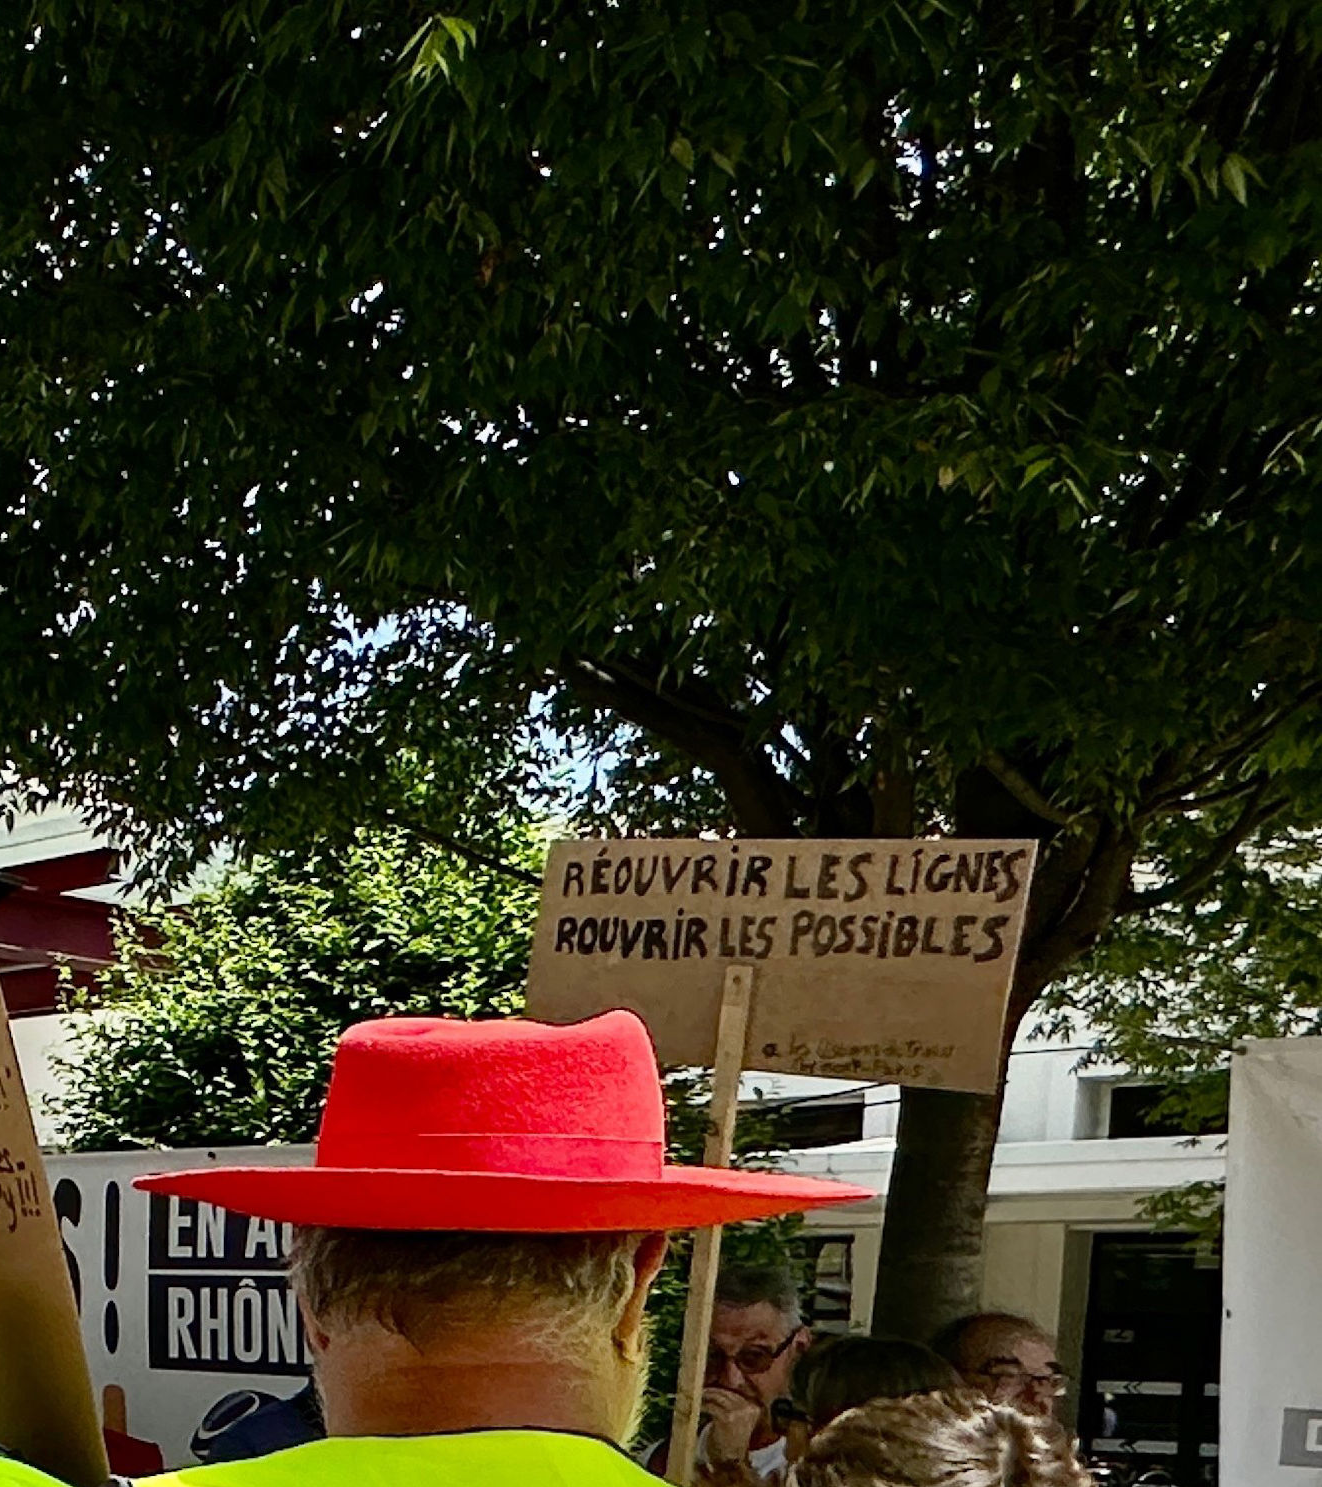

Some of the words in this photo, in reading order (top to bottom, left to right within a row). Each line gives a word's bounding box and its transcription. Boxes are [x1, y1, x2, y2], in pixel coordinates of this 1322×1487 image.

[784, 853, 873, 902] LES
[885, 849, 1027, 902] LIGNES
[555, 908, 708, 960] ROUVRIR
[718, 916, 777, 959] LES
[789, 909, 1010, 963] POSSIBLES
[168, 1195, 227, 1259] EN
[168, 1277, 313, 1364] RHÔN
